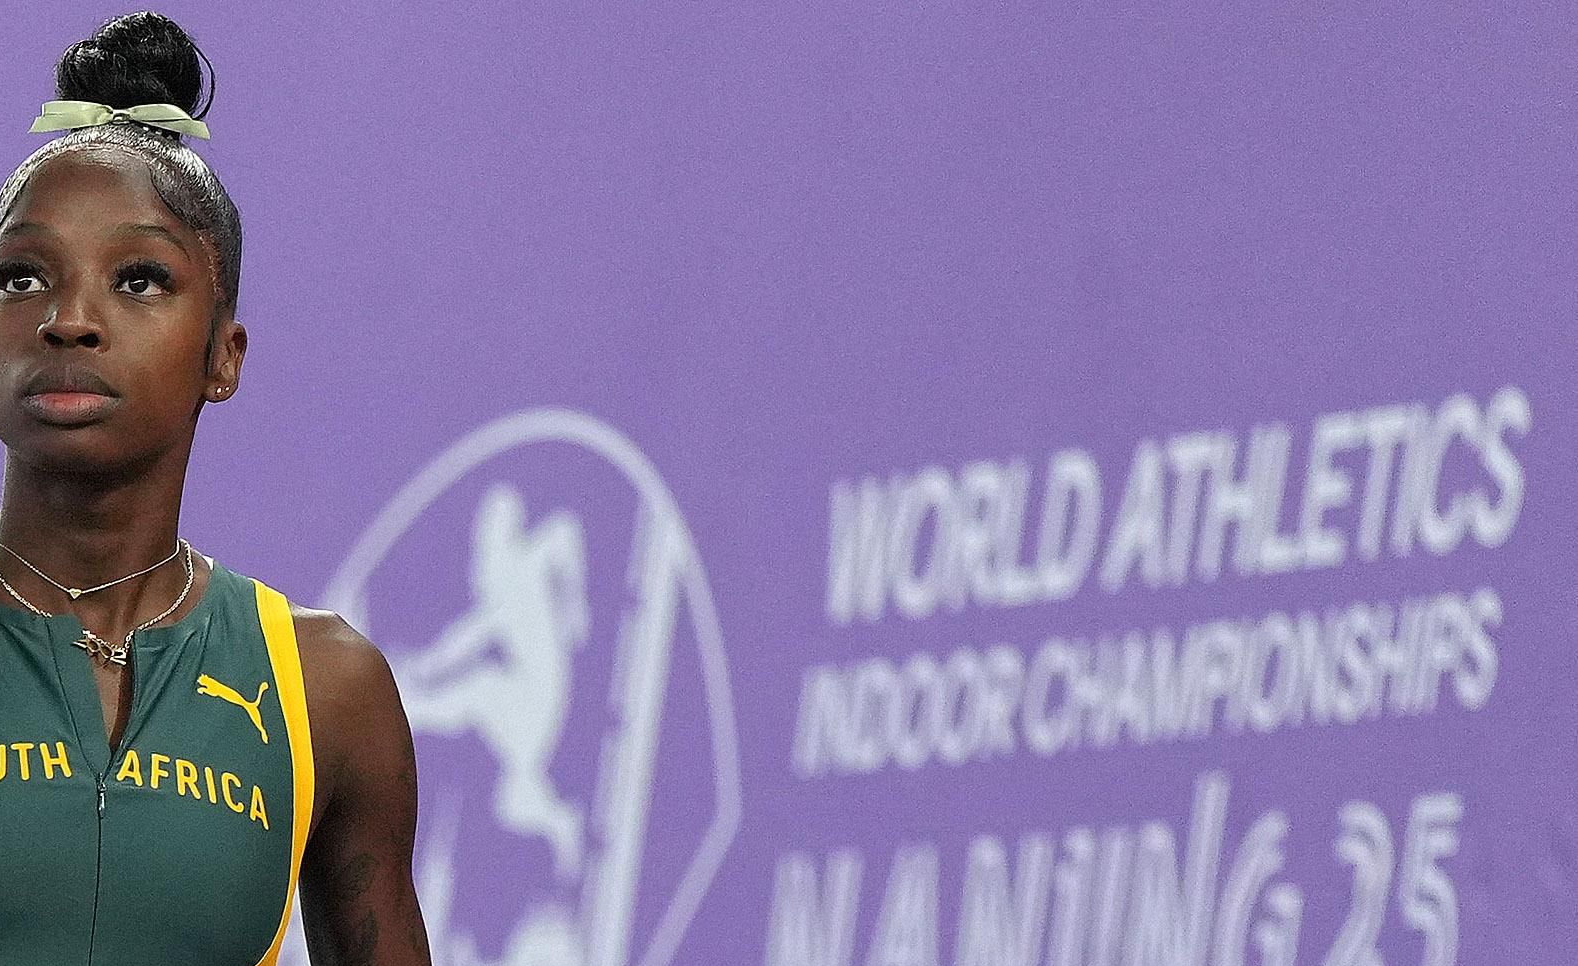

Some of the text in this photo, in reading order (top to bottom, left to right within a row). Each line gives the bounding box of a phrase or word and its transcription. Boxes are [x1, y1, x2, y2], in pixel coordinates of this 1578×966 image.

[826, 386, 1532, 622] WORLD ATHLETICS
[792, 588, 1504, 778] INDOOR CHAMPIONSHIPS
[116, 750, 269, 830] AFRICA
